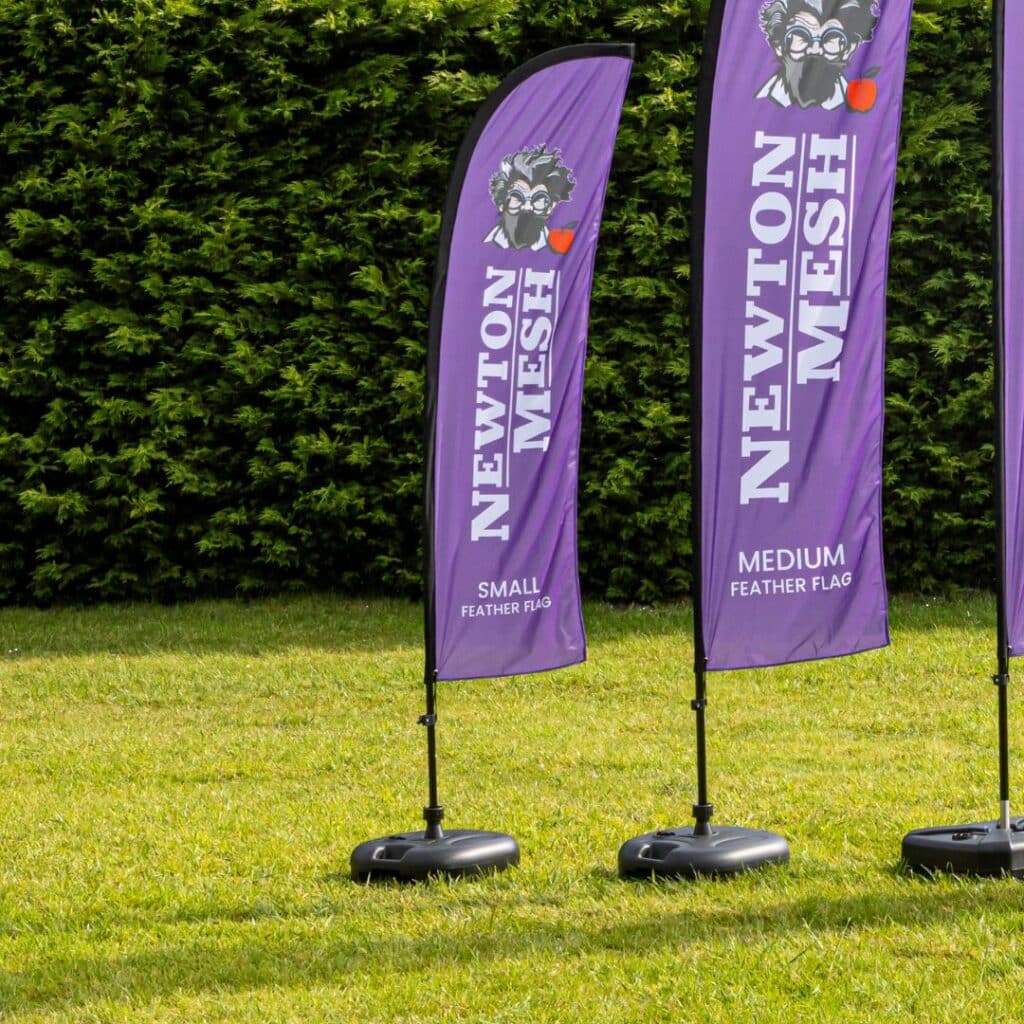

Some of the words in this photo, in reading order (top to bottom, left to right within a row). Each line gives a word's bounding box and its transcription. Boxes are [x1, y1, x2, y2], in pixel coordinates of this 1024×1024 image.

[797, 133, 849, 384] MESH
[513, 268, 555, 453] MESH
[740, 131, 796, 505] NEWTON
[471, 266, 516, 541] NEWTON
[462, 603, 520, 617] FEATHER
[524, 596, 552, 611] FLAG
[478, 577, 541, 599] SMALL
[730, 577, 806, 596] FEATHER
[812, 572, 852, 591] FLAG
[738, 544, 846, 573] MEDIUM
